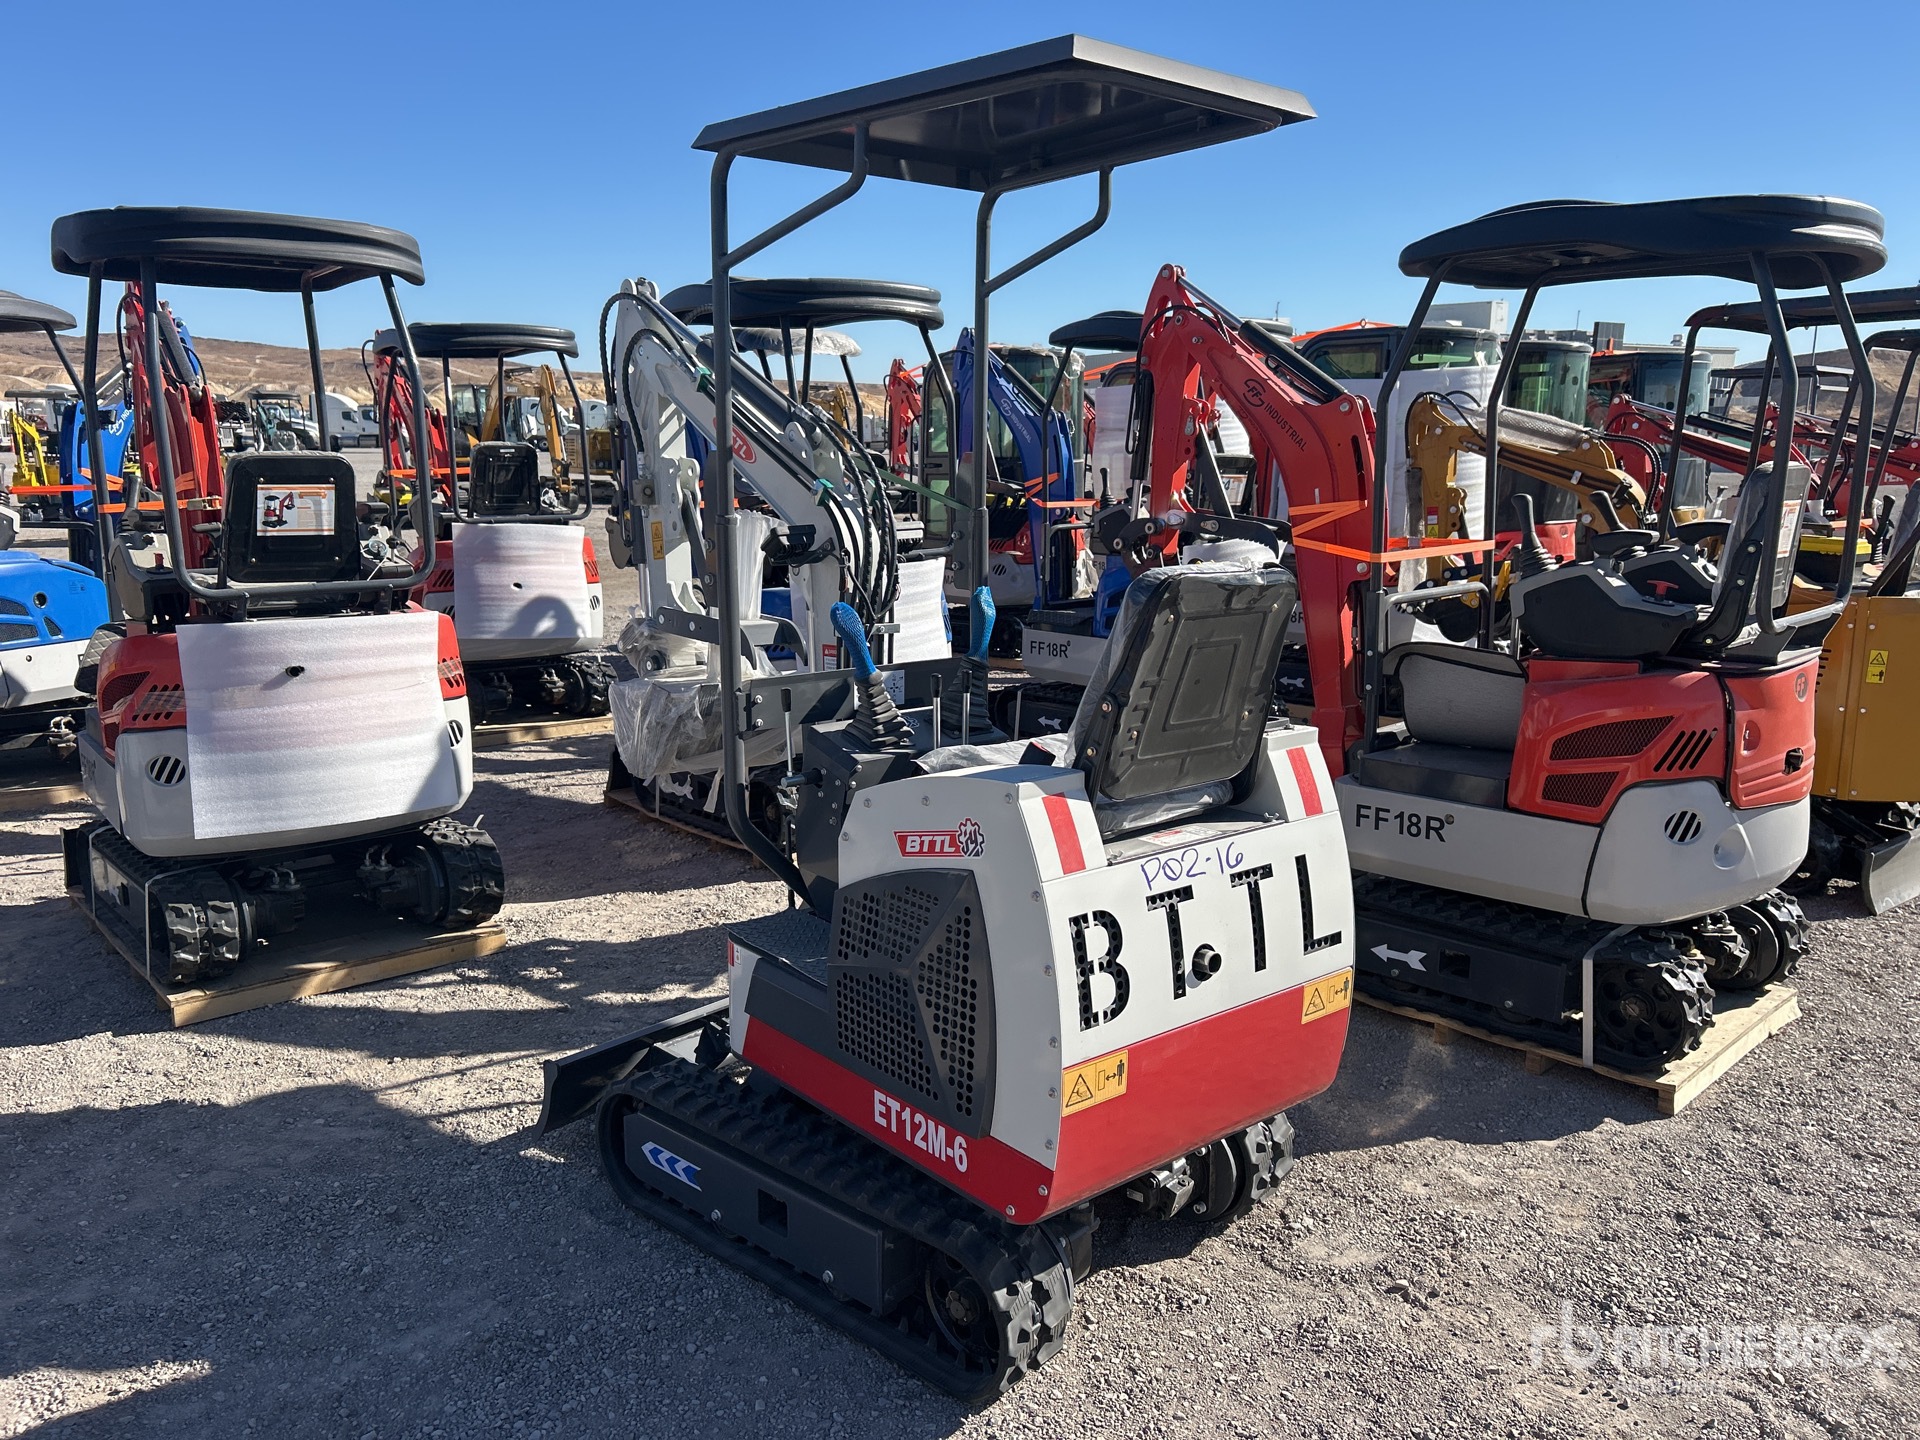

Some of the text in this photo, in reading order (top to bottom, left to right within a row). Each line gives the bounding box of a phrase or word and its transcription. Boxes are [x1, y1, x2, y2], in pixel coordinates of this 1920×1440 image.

[1264, 402, 1307, 452] INDUSTRIAL
[1030, 640, 1069, 659] FF18R
[1355, 803, 1446, 843] FF18R
[905, 834, 957, 853] BTTL
[873, 1089, 968, 1173] ET12M-6
